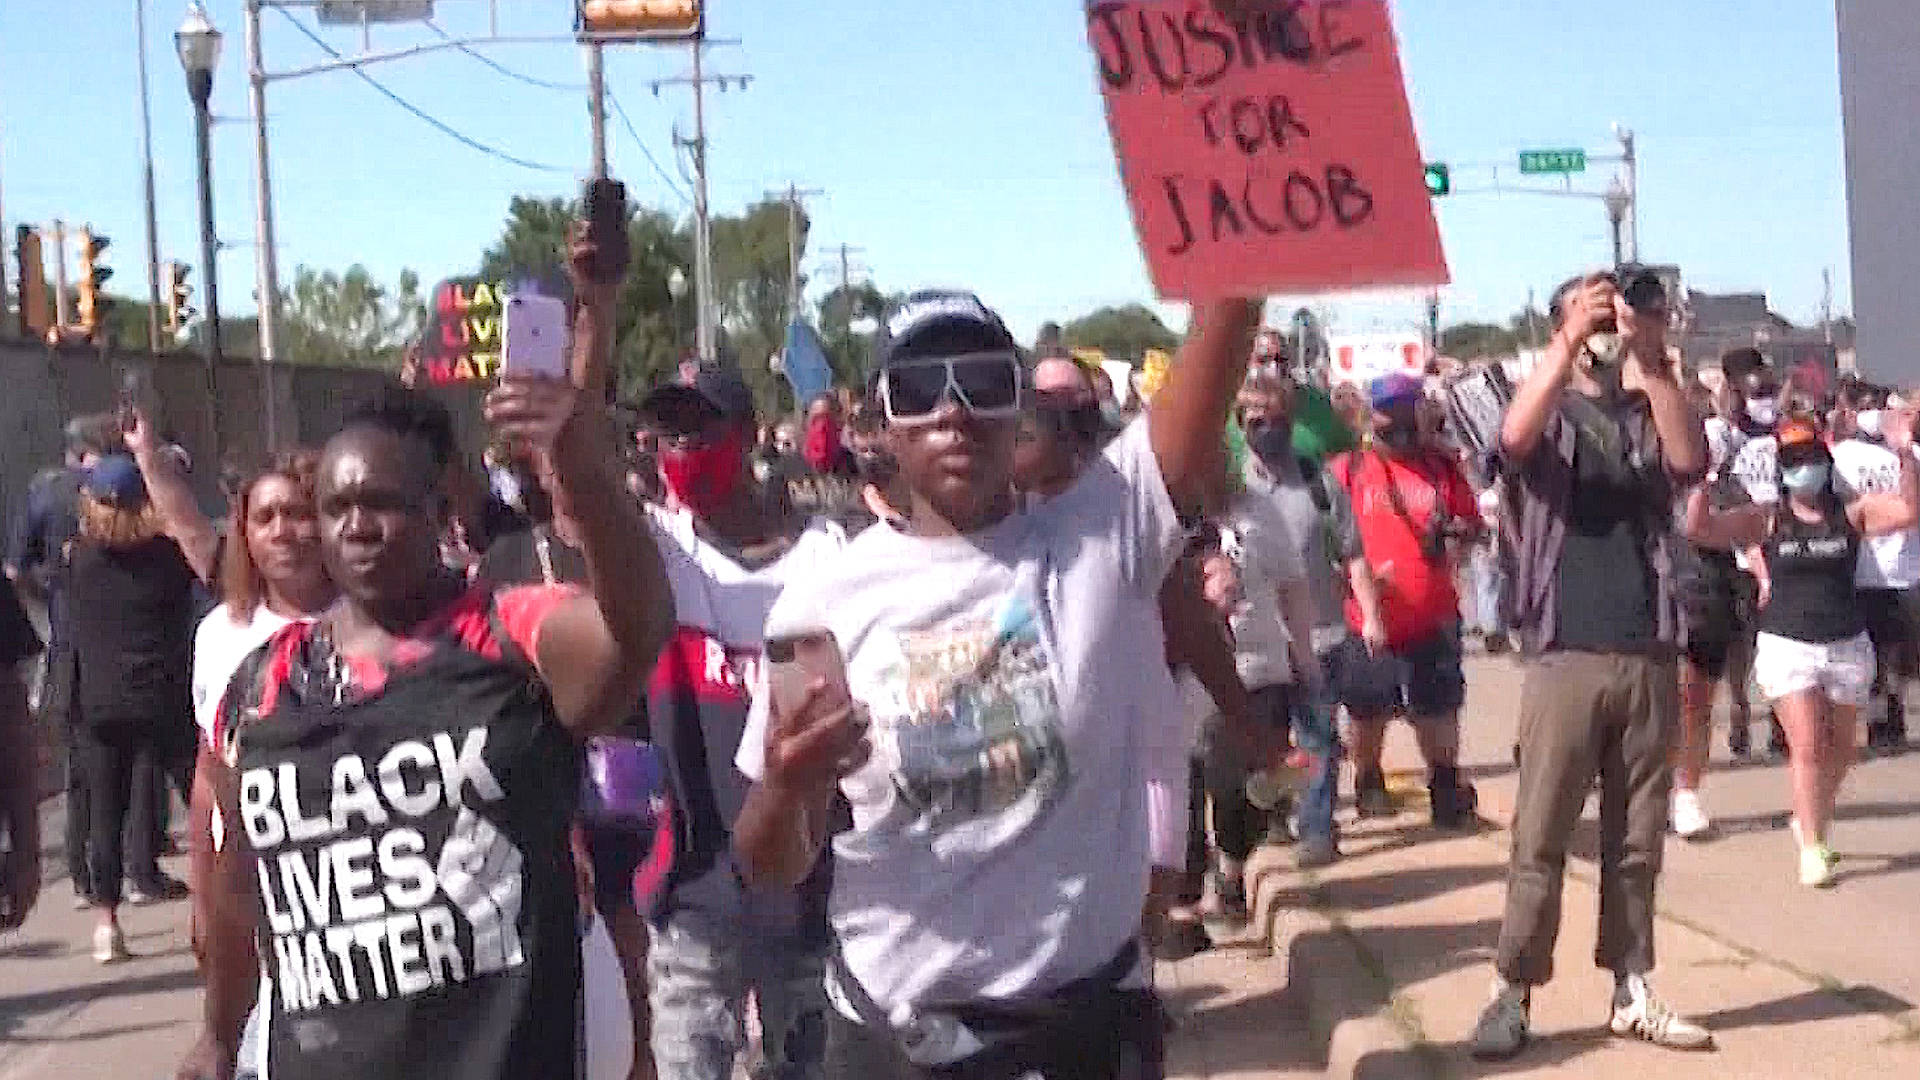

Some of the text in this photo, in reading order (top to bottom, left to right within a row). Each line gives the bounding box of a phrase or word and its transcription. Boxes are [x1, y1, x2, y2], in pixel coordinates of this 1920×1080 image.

[1198, 96, 1311, 154] FOR
[1159, 164, 1374, 255] JACOB
[240, 727, 505, 848] BLACK
[257, 828, 437, 934] LIVES
[272, 905, 466, 1012] MATTER
